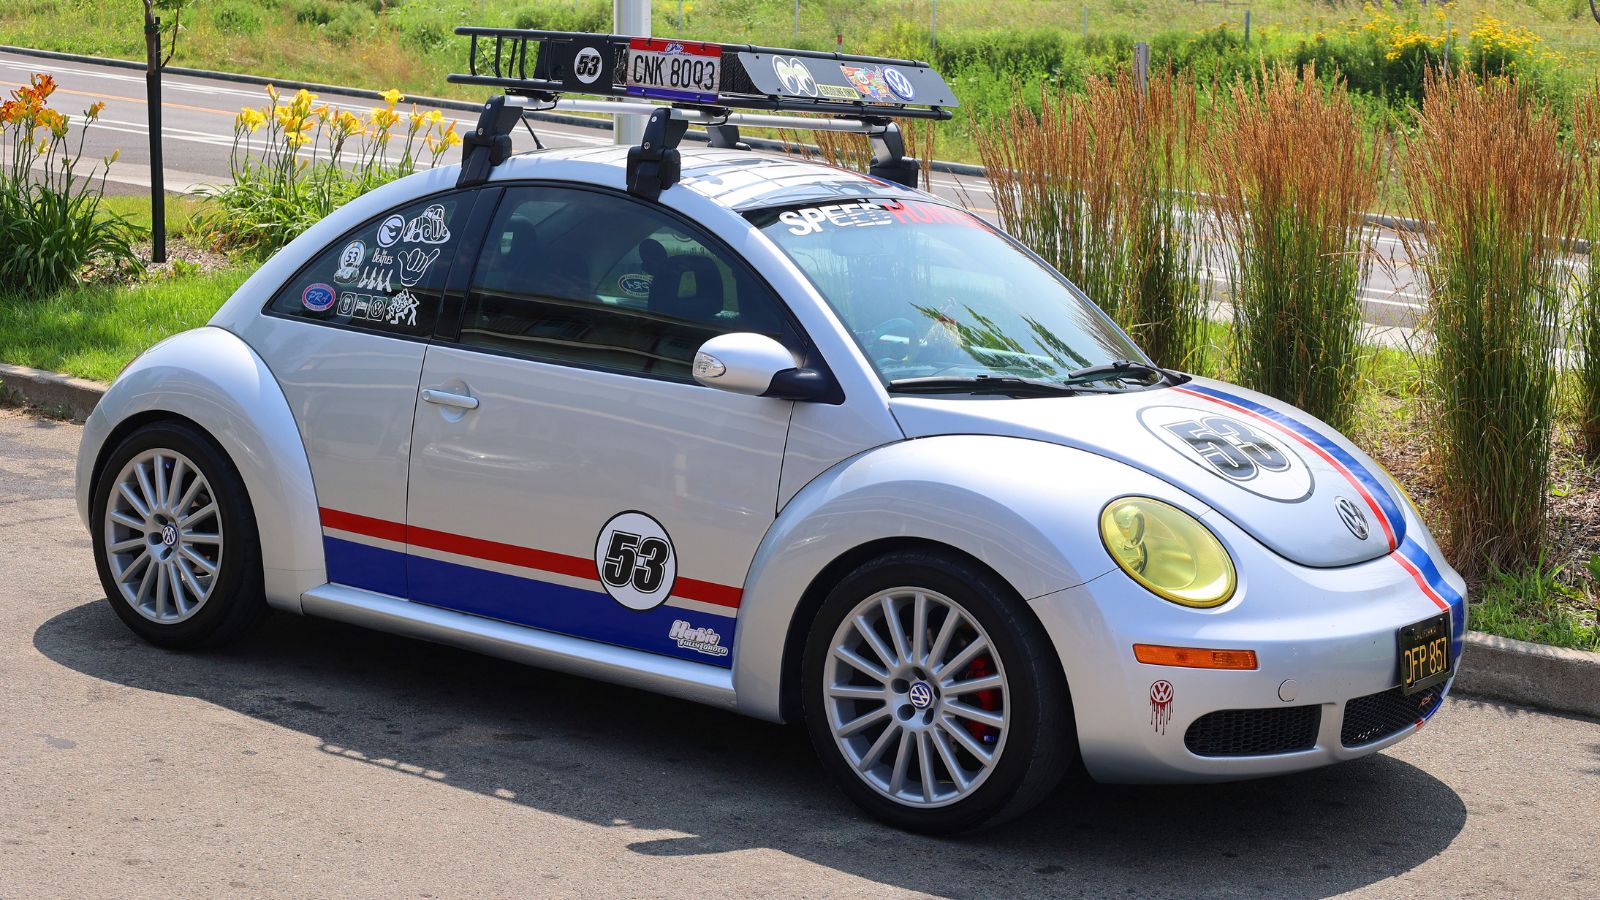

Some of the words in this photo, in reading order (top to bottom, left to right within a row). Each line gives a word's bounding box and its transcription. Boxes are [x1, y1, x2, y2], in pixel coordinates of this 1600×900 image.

[577, 54, 600, 76] 53
[633, 55, 666, 86] CNK
[346, 251, 359, 263] 53
[1161, 416, 1291, 482] 53
[602, 530, 670, 594] 53
[670, 620, 719, 646] Herbie
[1429, 636, 1447, 674] 857
